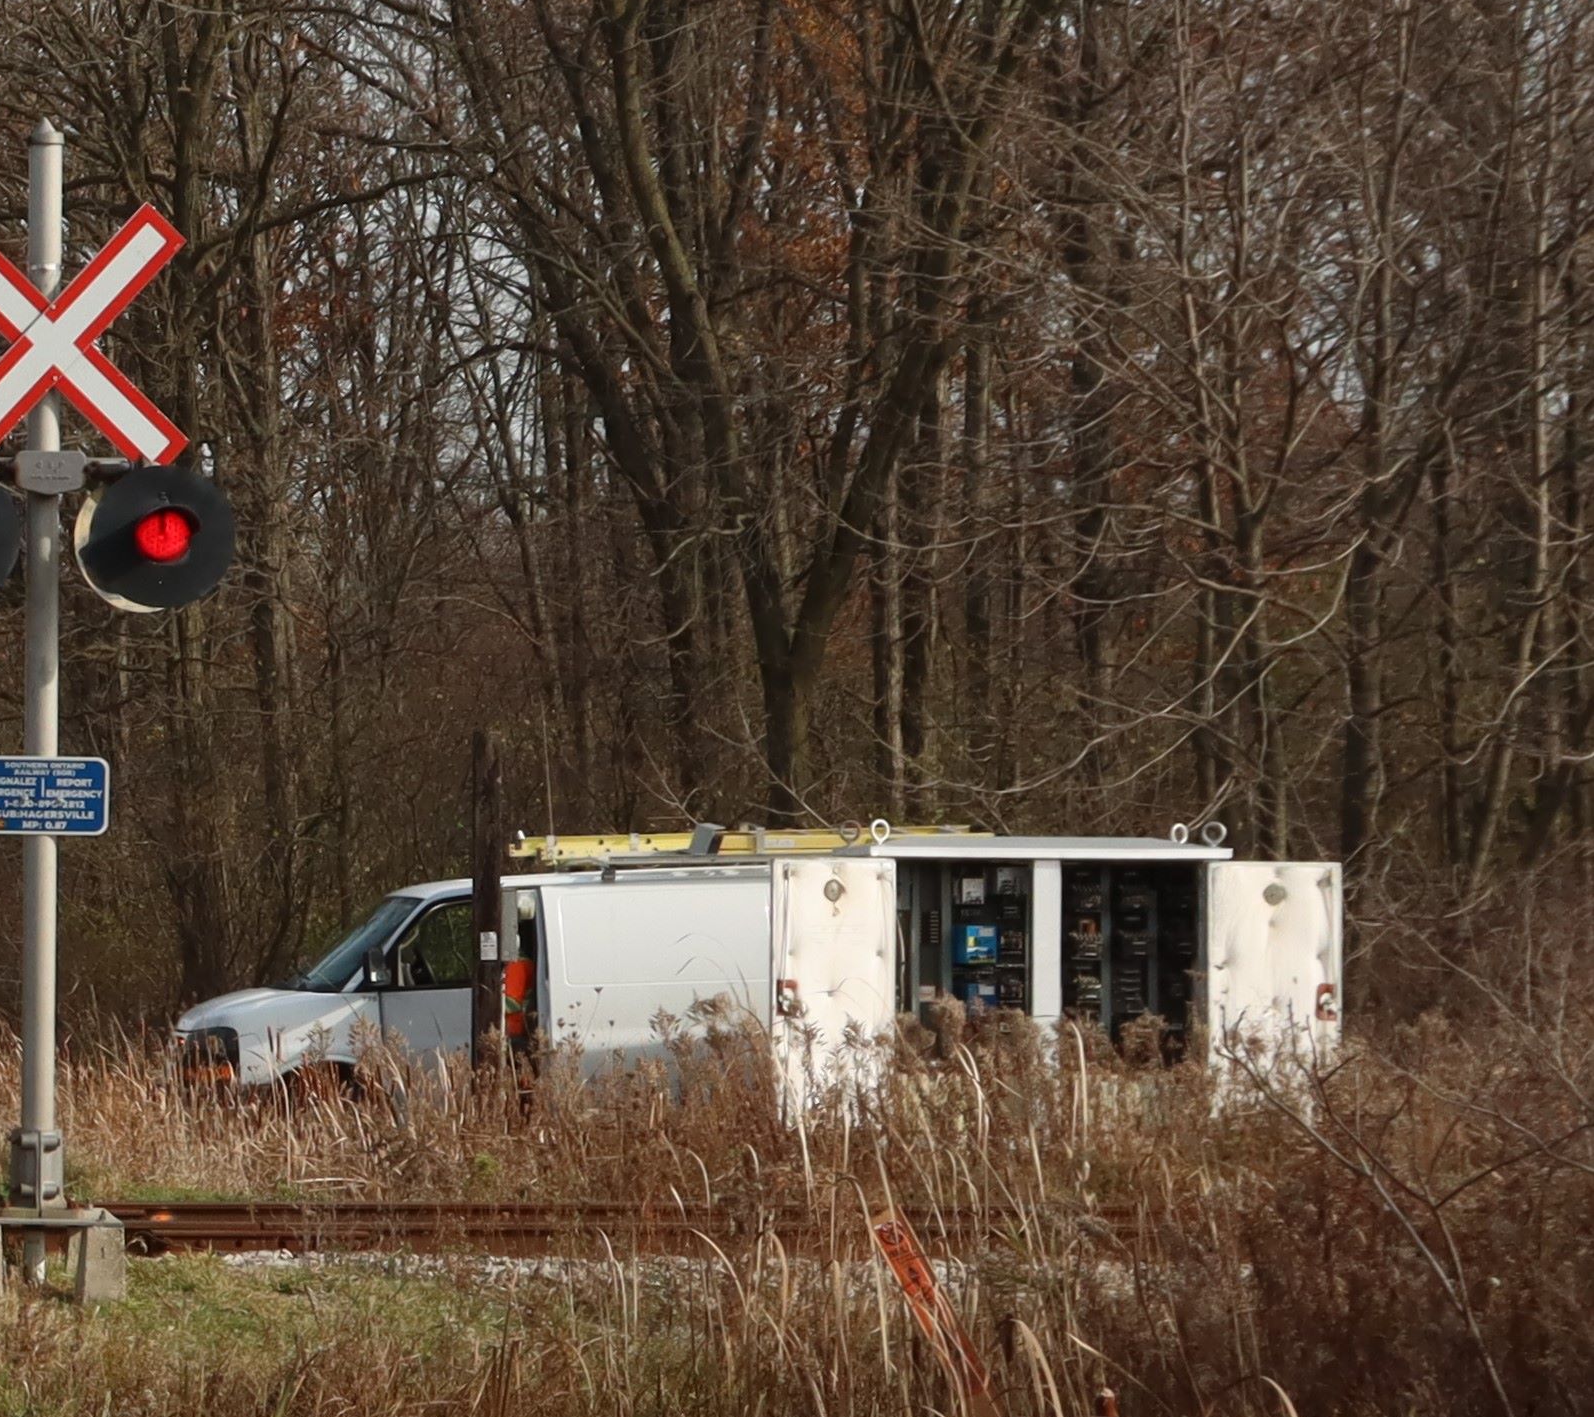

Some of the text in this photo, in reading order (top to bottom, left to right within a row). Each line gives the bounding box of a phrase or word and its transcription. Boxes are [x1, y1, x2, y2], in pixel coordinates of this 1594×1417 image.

[4, 761, 86, 770] SOUTHERN ONTARIO
[56, 778, 93, 787] REPORT
[46, 789, 103, 798] EMERGENCY
[22, 820, 42, 829] MP:
